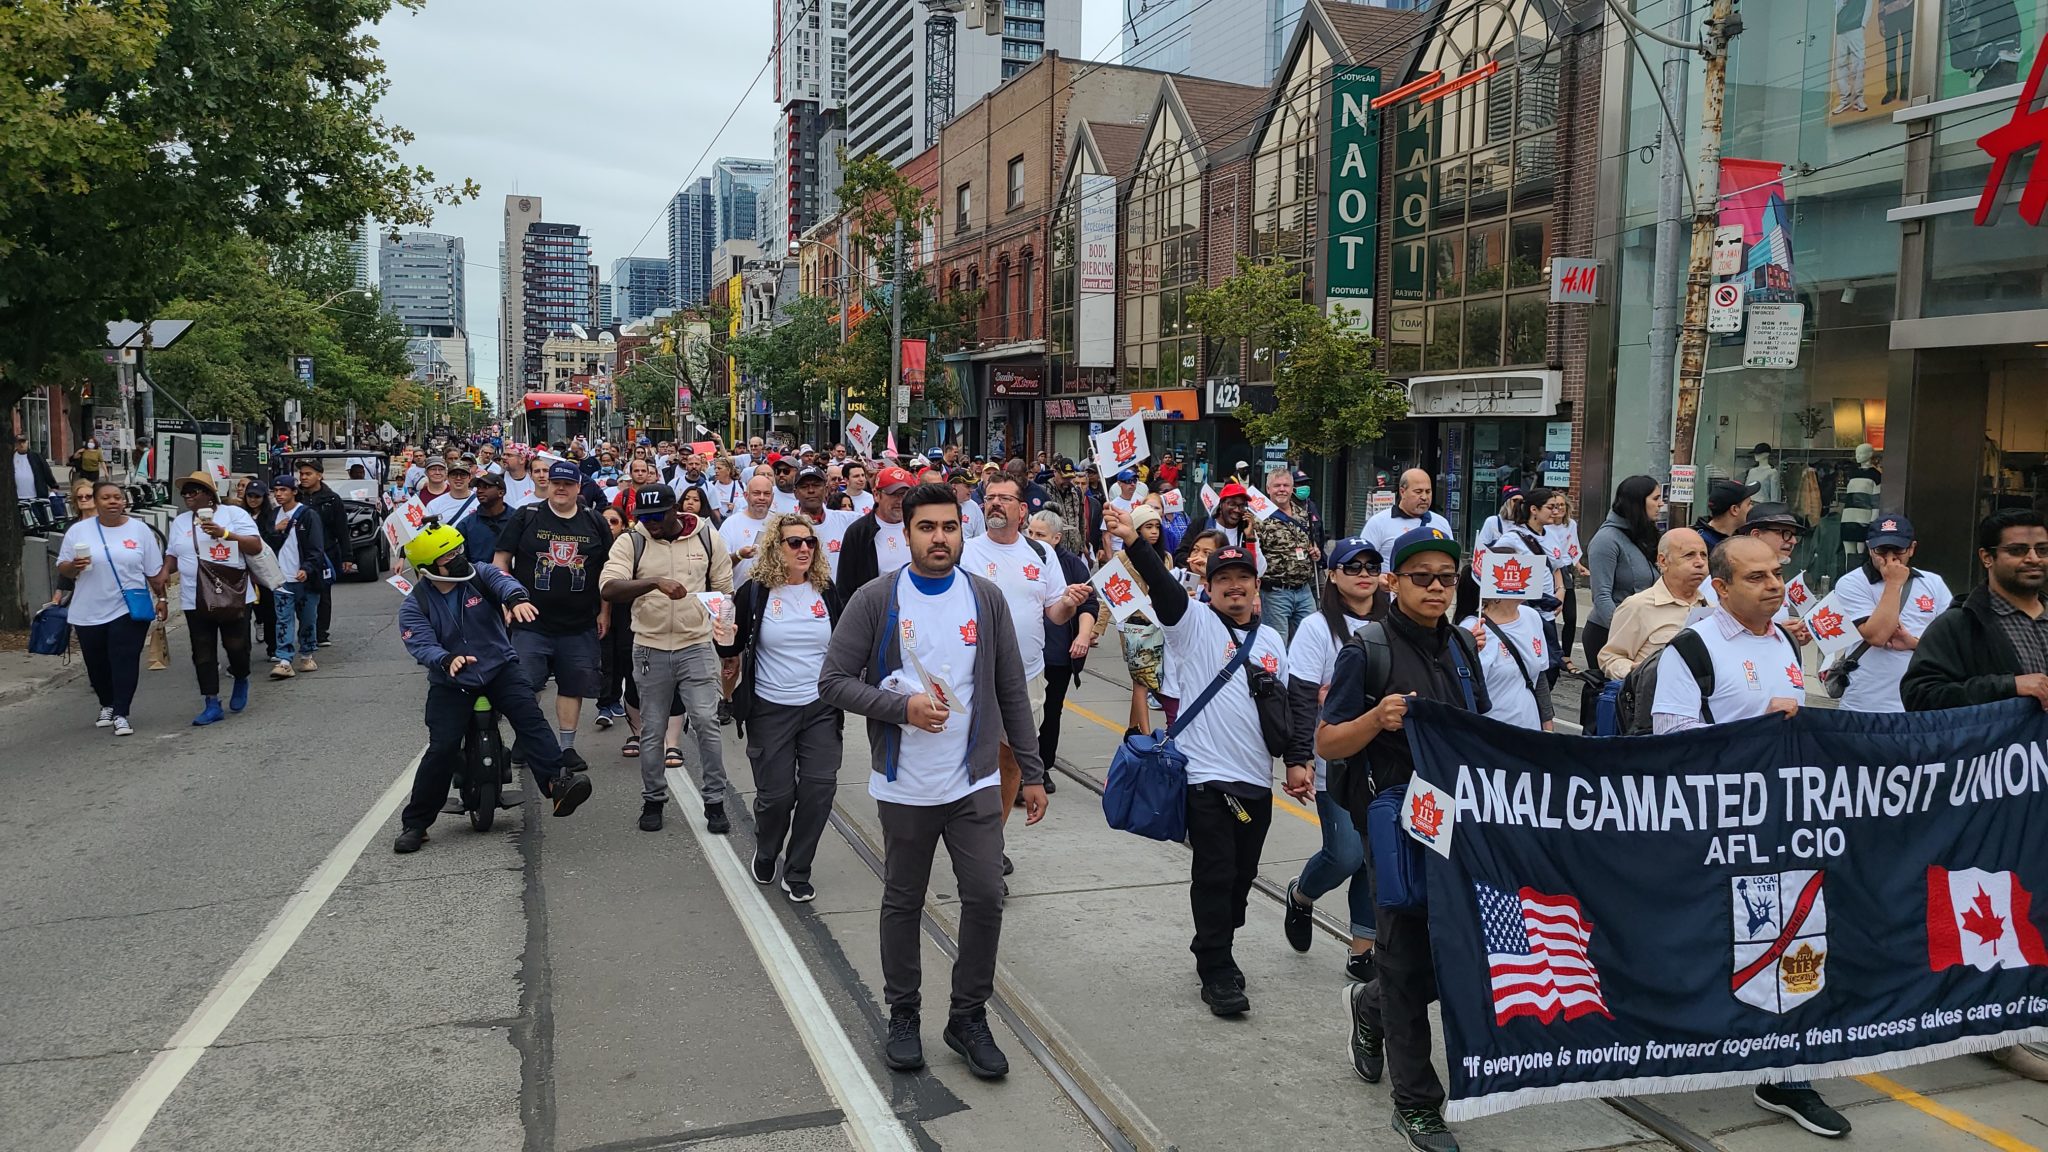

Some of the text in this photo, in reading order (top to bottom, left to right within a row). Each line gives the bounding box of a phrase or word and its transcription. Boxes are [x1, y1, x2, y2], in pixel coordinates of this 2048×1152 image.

[1338, 93, 1369, 270] NAOT
[1088, 243, 1107, 258] BODY
[1081, 261, 1114, 276] PIERCING
[1560, 266, 1597, 295] H&M
[1331, 287, 1369, 295] FOOTWEAR
[1182, 355, 1195, 368] 423
[1215, 384, 1240, 408] 423
[1266, 451, 1275, 459] FOR
[1549, 461, 1570, 470] LEASE
[640, 491, 661, 505] YTZ
[560, 535, 591, 543] SERVICE
[1503, 571, 1521, 581] 113
[1112, 582, 1125, 597] 113
[1820, 616, 1834, 631] 113
[904, 629, 915, 639] 50
[1227, 650, 1235, 659] 50
[1747, 671, 1758, 681] 50
[1455, 740, 2048, 831] AMALGAMATED TRANSIT UNION
[1424, 799, 1434, 809] ATU
[1419, 806, 1434, 824] 113
[1415, 818, 1434, 832] TORONTO
[1703, 834, 1769, 865] AFL
[1791, 827, 1846, 859] CIO
[1753, 876, 1778, 884] LOCAL
[1768, 902, 1809, 960] IN SOLIDARITY
[1792, 961, 1812, 974] 113
[1788, 973, 1817, 981] TORONTO
[1483, 1052, 1553, 1076] everyone
[1557, 1046, 1571, 1067] is
[1576, 1041, 1640, 1065] moving
[1645, 1039, 1720, 1060] forward
[1722, 1033, 1800, 1058] together,
[1805, 1027, 1842, 1046] then
[1847, 1019, 1916, 1041] success
[1920, 1008, 1962, 1029] takes
[1966, 1002, 2002, 1021] care
[2006, 996, 2026, 1015] of
